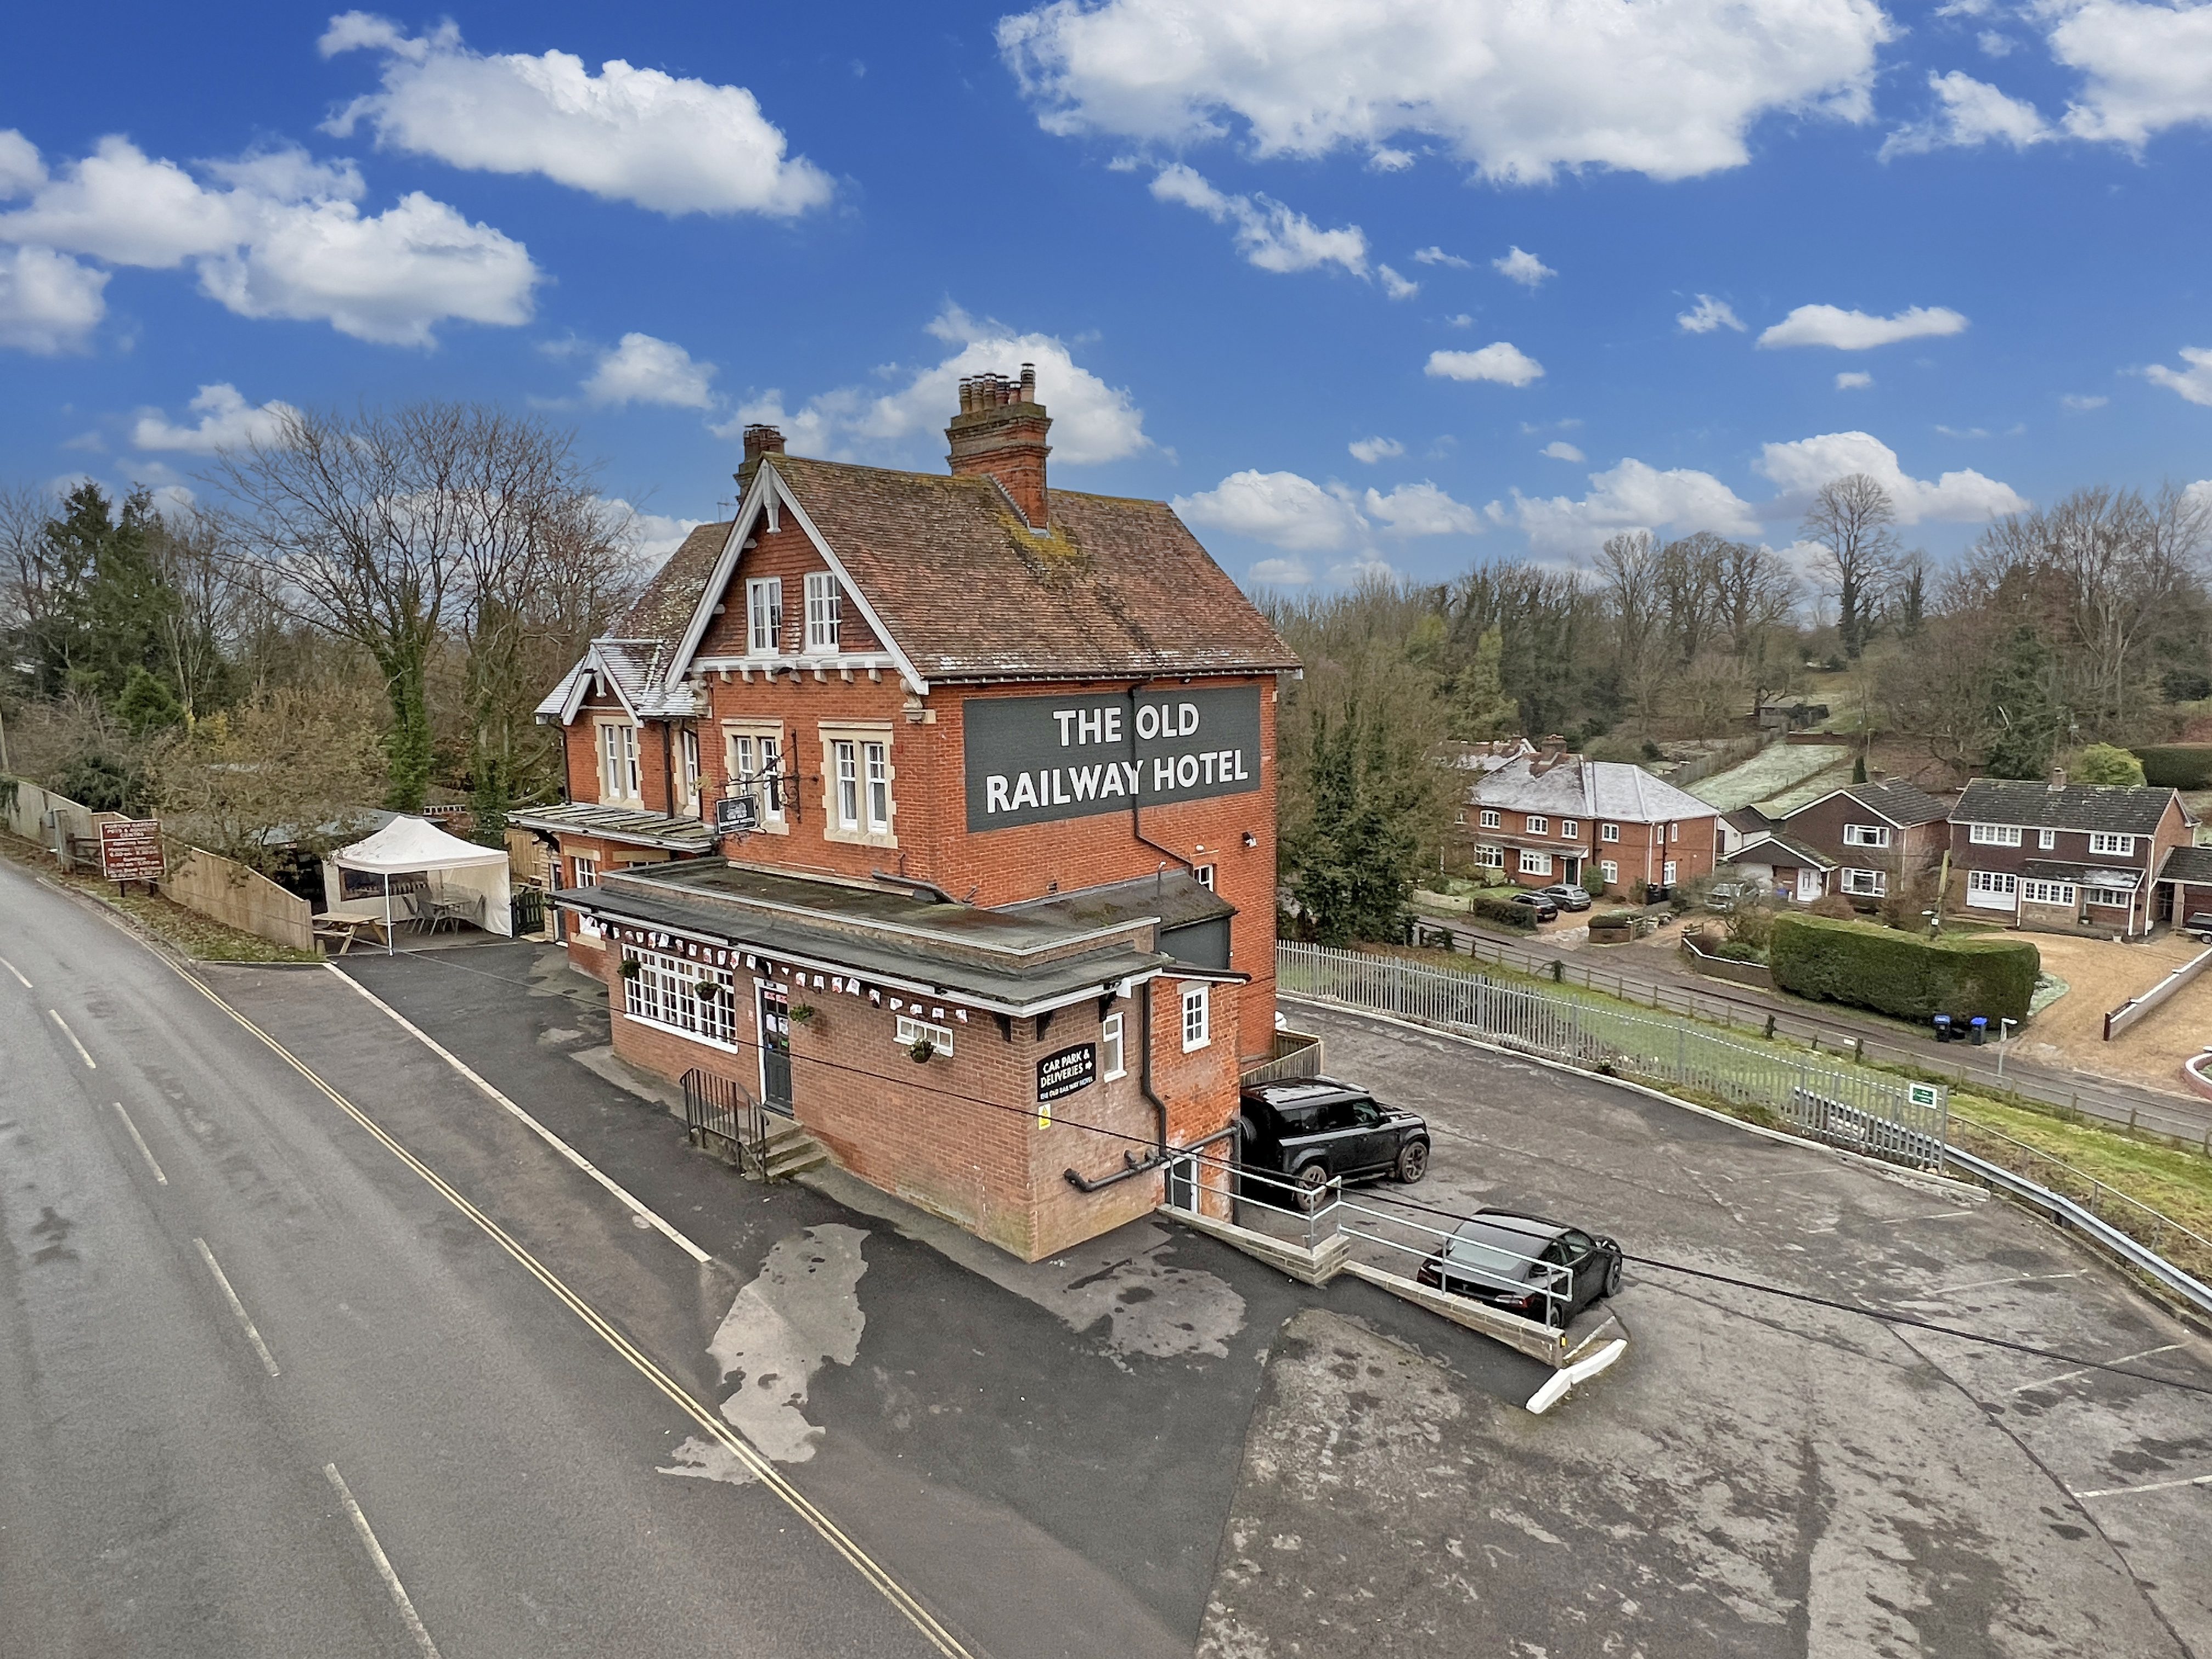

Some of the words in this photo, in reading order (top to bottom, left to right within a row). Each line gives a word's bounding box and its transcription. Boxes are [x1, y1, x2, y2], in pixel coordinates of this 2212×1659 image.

[1053, 707, 1122, 747] THE
[1136, 703, 1199, 740] OLD
[986, 759, 1144, 814] RAILWAY
[1154, 749, 1249, 791] HOTEL
[1041, 1063, 1084, 1088] DELIVERIES
[1043, 1059, 1060, 1074] CAR
[1062, 1051, 1082, 1067] PARK
[1084, 1049, 1090, 1059] &
